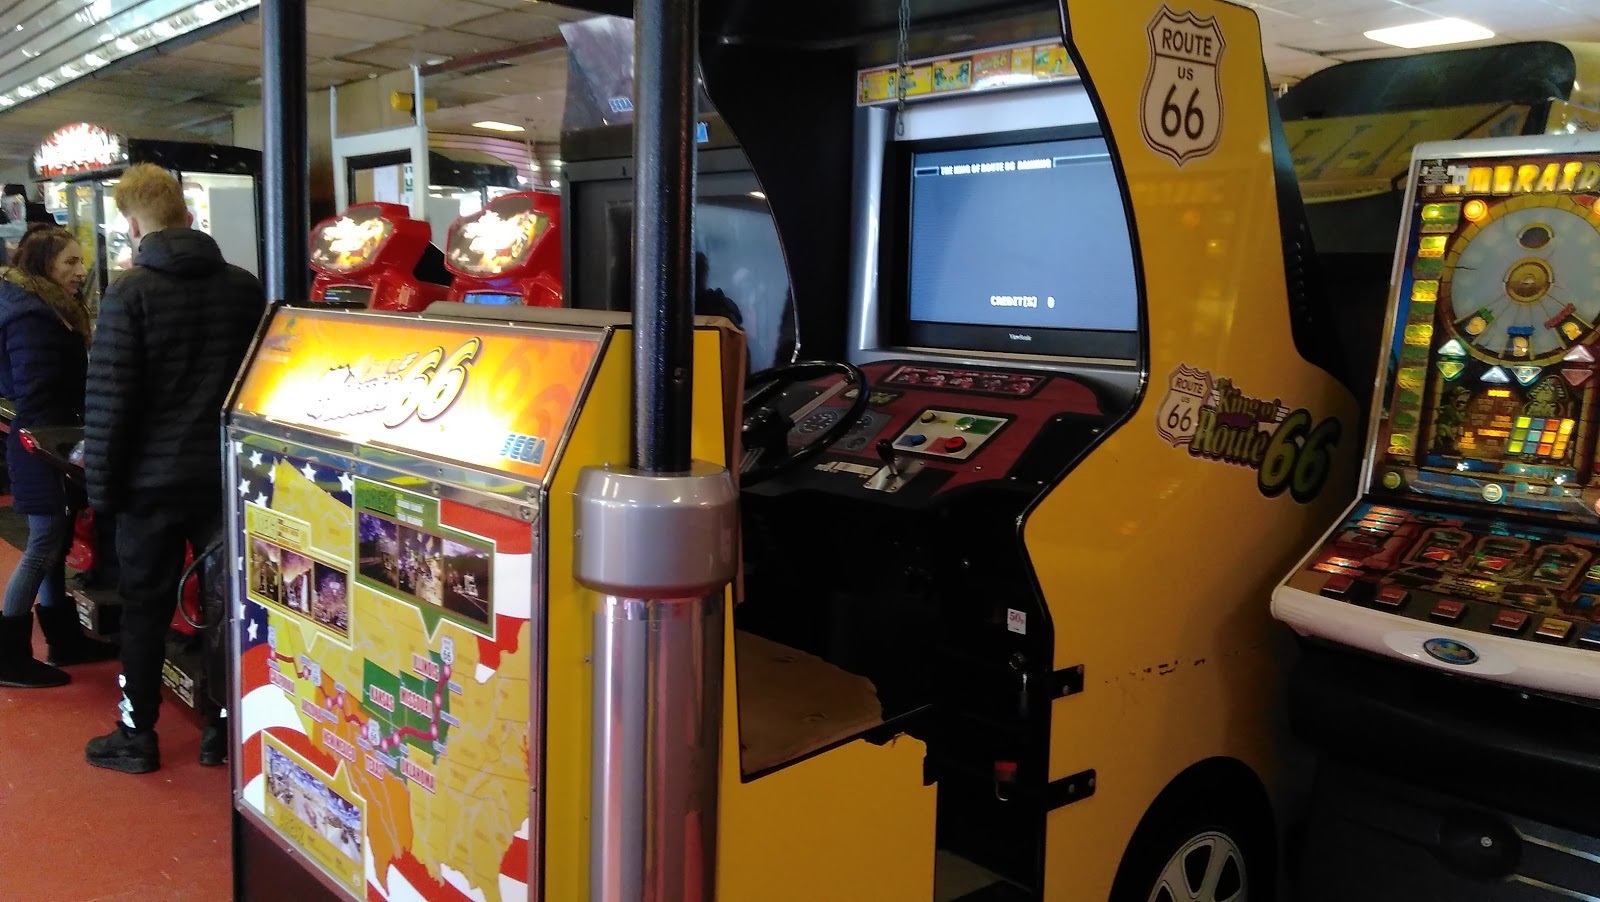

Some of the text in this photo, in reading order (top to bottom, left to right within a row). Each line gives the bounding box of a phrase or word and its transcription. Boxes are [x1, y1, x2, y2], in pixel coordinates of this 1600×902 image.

[1162, 28, 1212, 57] ROUTE
[1177, 66, 1194, 81] US
[1161, 83, 1204, 140] 66
[1046, 296, 1056, 309] 0
[384, 336, 483, 429] 66
[1175, 377, 1204, 396] ROUTE
[1167, 404, 1193, 432] 66
[499, 433, 546, 465] SEGA
[1188, 405, 1343, 505] Route 66
